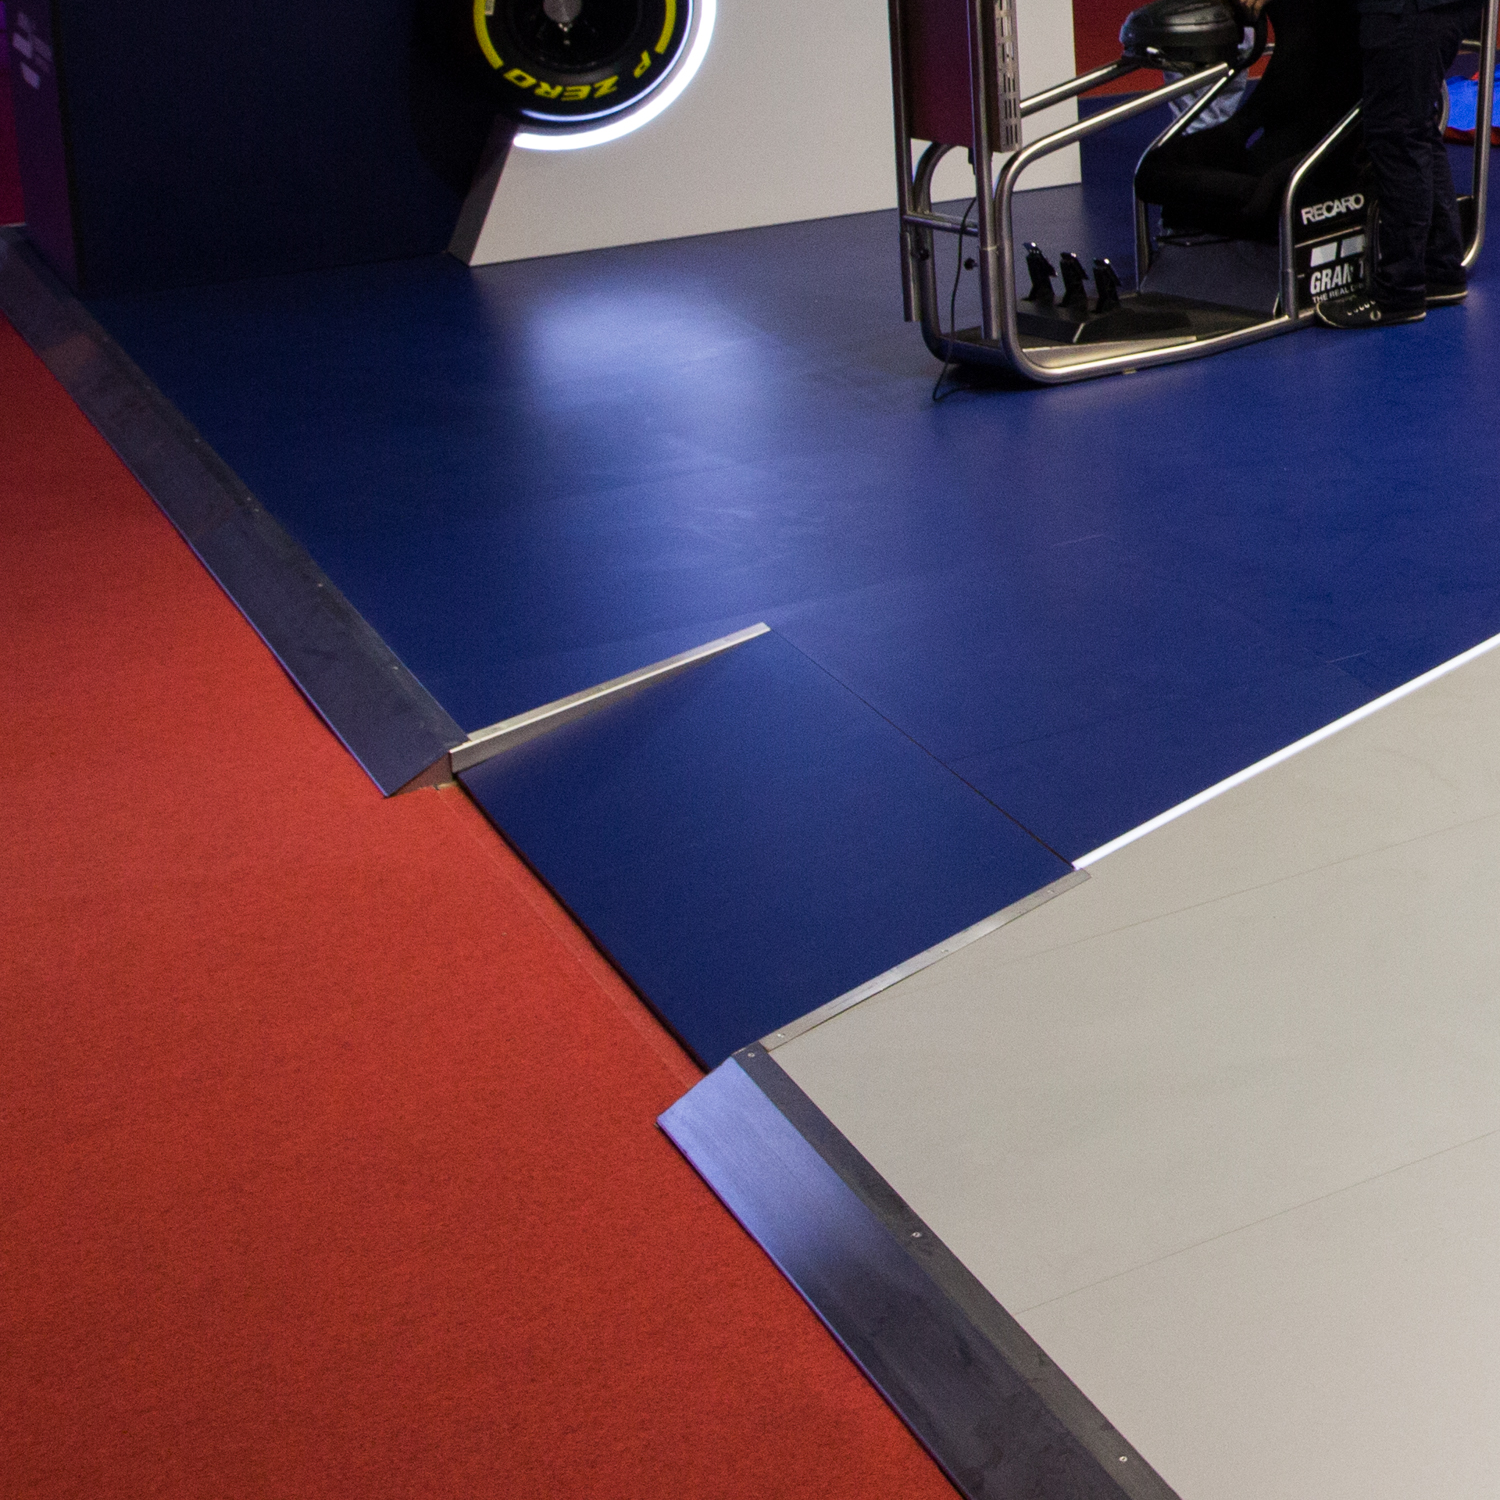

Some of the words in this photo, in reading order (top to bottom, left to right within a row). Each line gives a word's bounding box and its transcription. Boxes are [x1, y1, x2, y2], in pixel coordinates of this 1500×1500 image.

[633, 50, 651, 79] P
[503, 67, 619, 102] ZERO
[1301, 193, 1365, 226] RECARO
